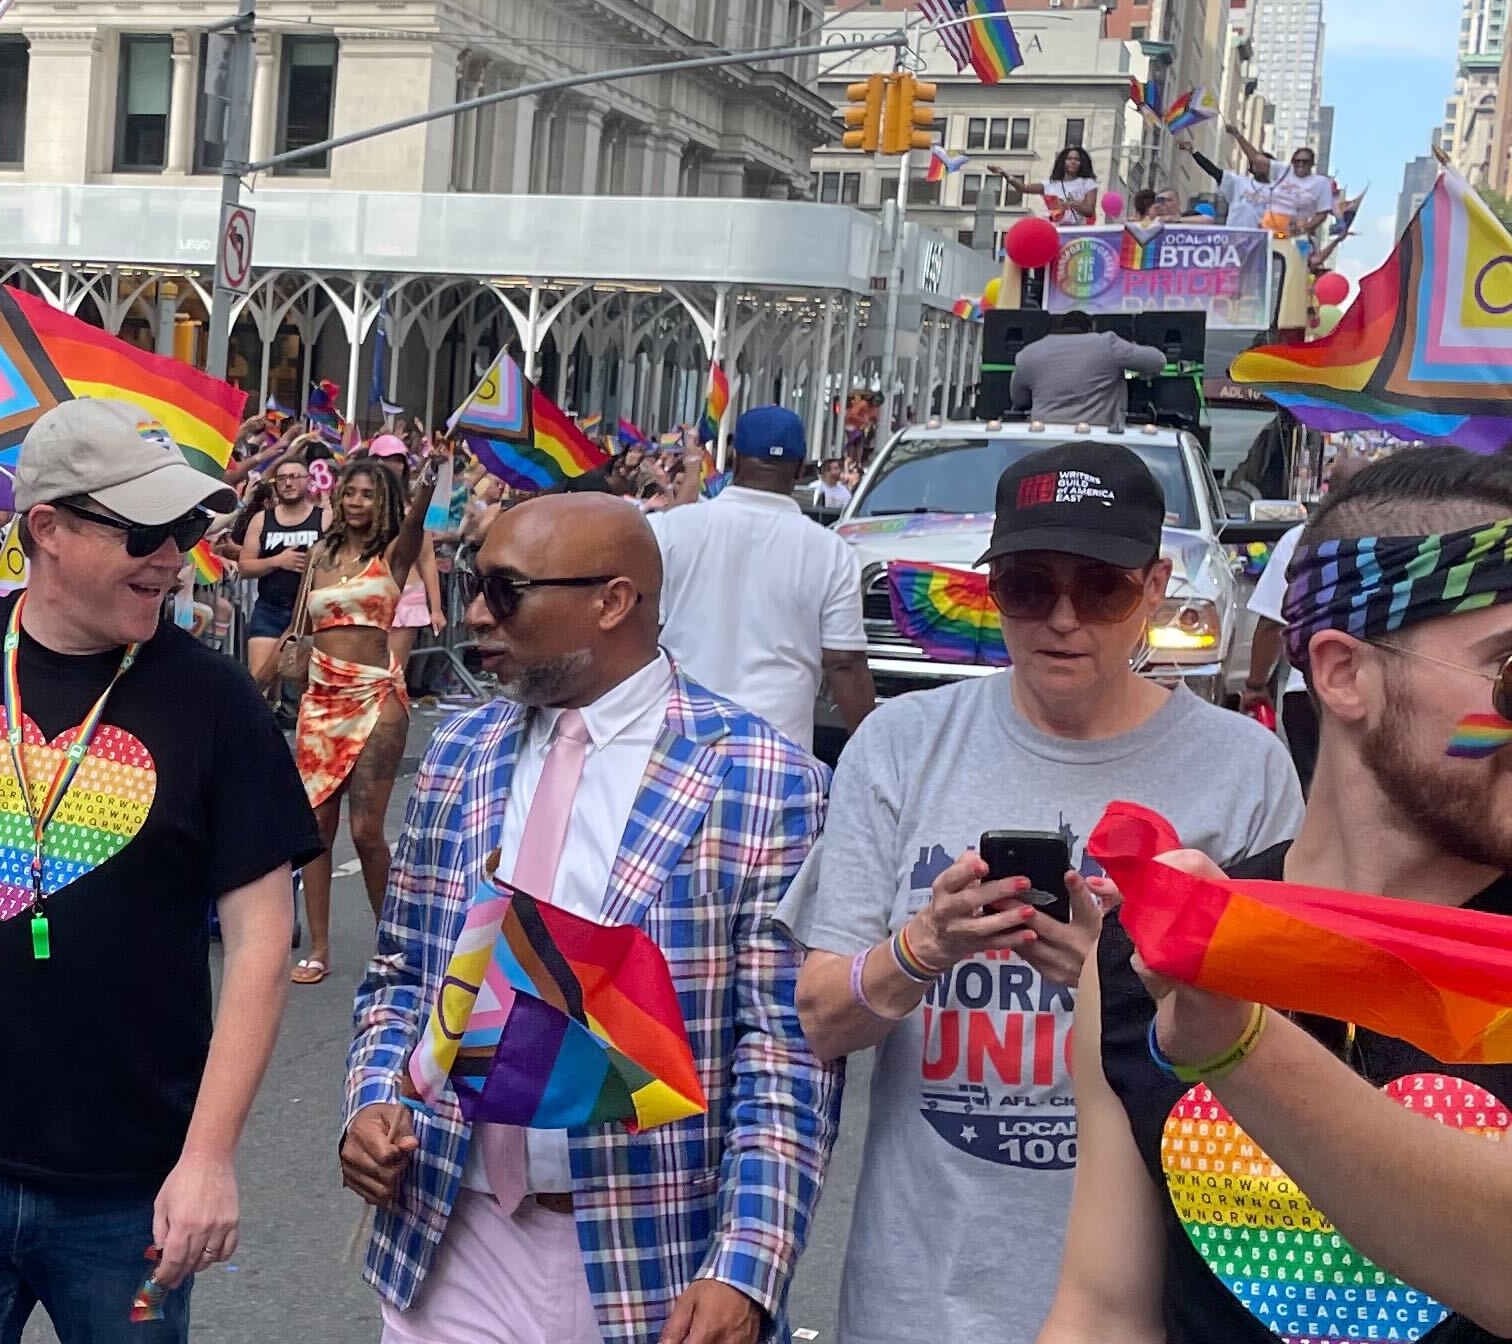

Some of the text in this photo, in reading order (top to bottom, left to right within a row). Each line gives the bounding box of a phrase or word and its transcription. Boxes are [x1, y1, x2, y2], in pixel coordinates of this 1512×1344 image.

[1163, 233, 1202, 245] OCAL
[1159, 245, 1242, 268] BTQIA
[1122, 268, 1240, 296] PRIDE
[1057, 478, 1089, 488] GUILD
[1059, 470, 1102, 485] WRITERS
[1055, 494, 1083, 503] EAST
[1069, 488, 1115, 500] AMERICA
[921, 1007, 1075, 1086] UNI
[1000, 1096, 1037, 1107] AFL
